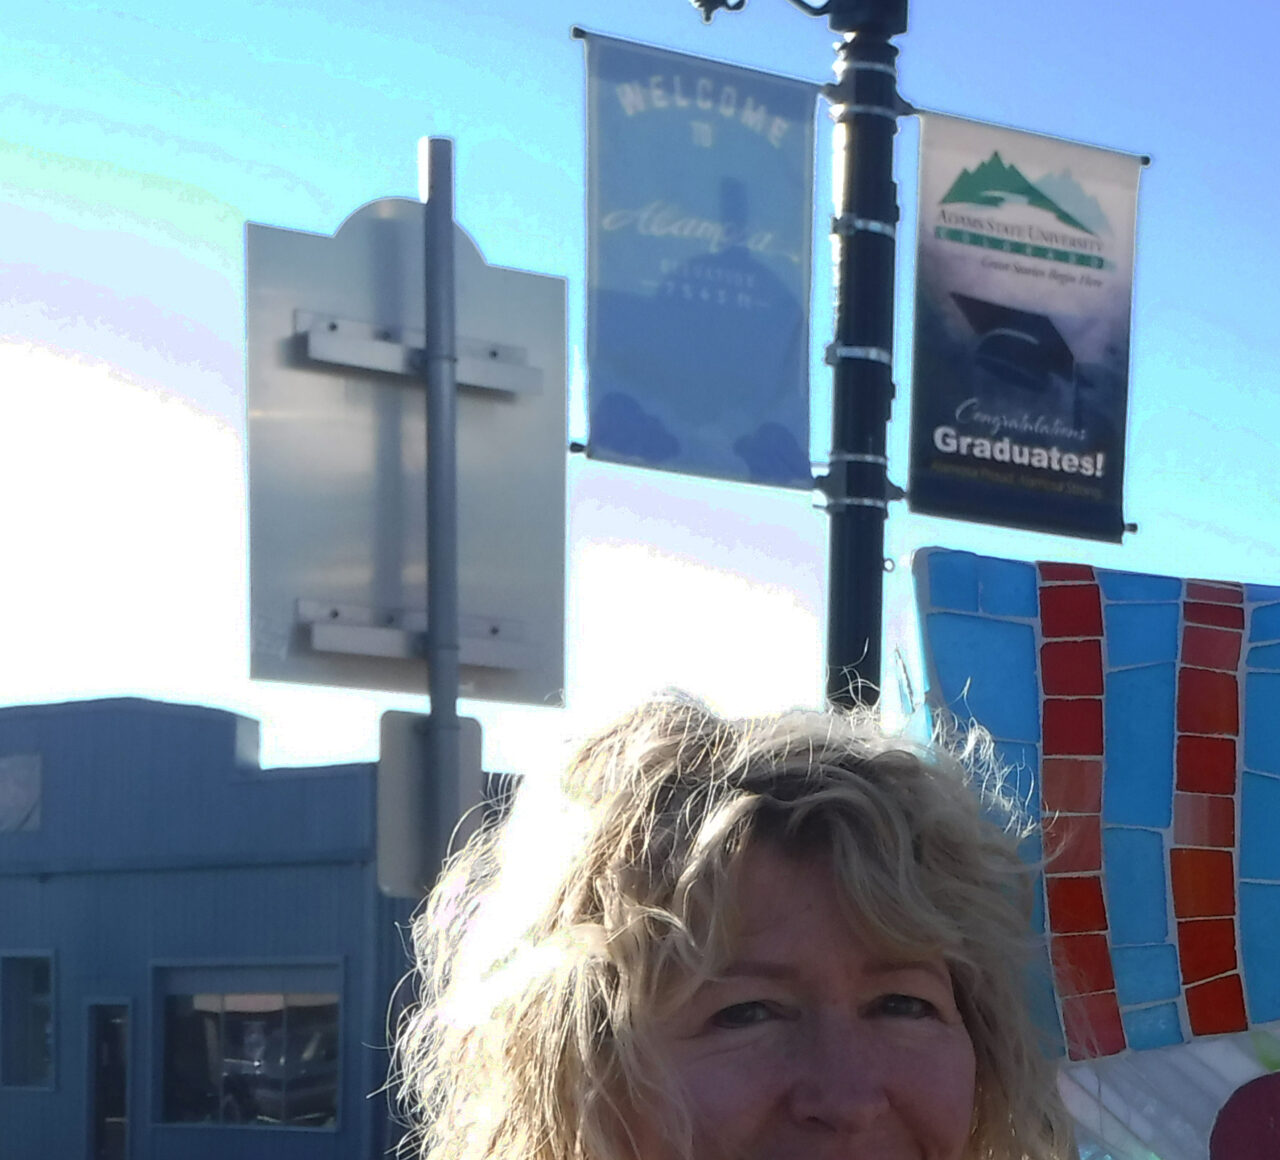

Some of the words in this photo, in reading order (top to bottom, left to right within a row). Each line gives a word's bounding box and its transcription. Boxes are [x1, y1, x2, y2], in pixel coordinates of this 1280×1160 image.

[616, 75, 789, 149] WELCOME
[1027, 223, 1103, 252] UNIVERSITY
[955, 397, 1087, 441] Congratulations
[933, 425, 1105, 478] Graduates!
